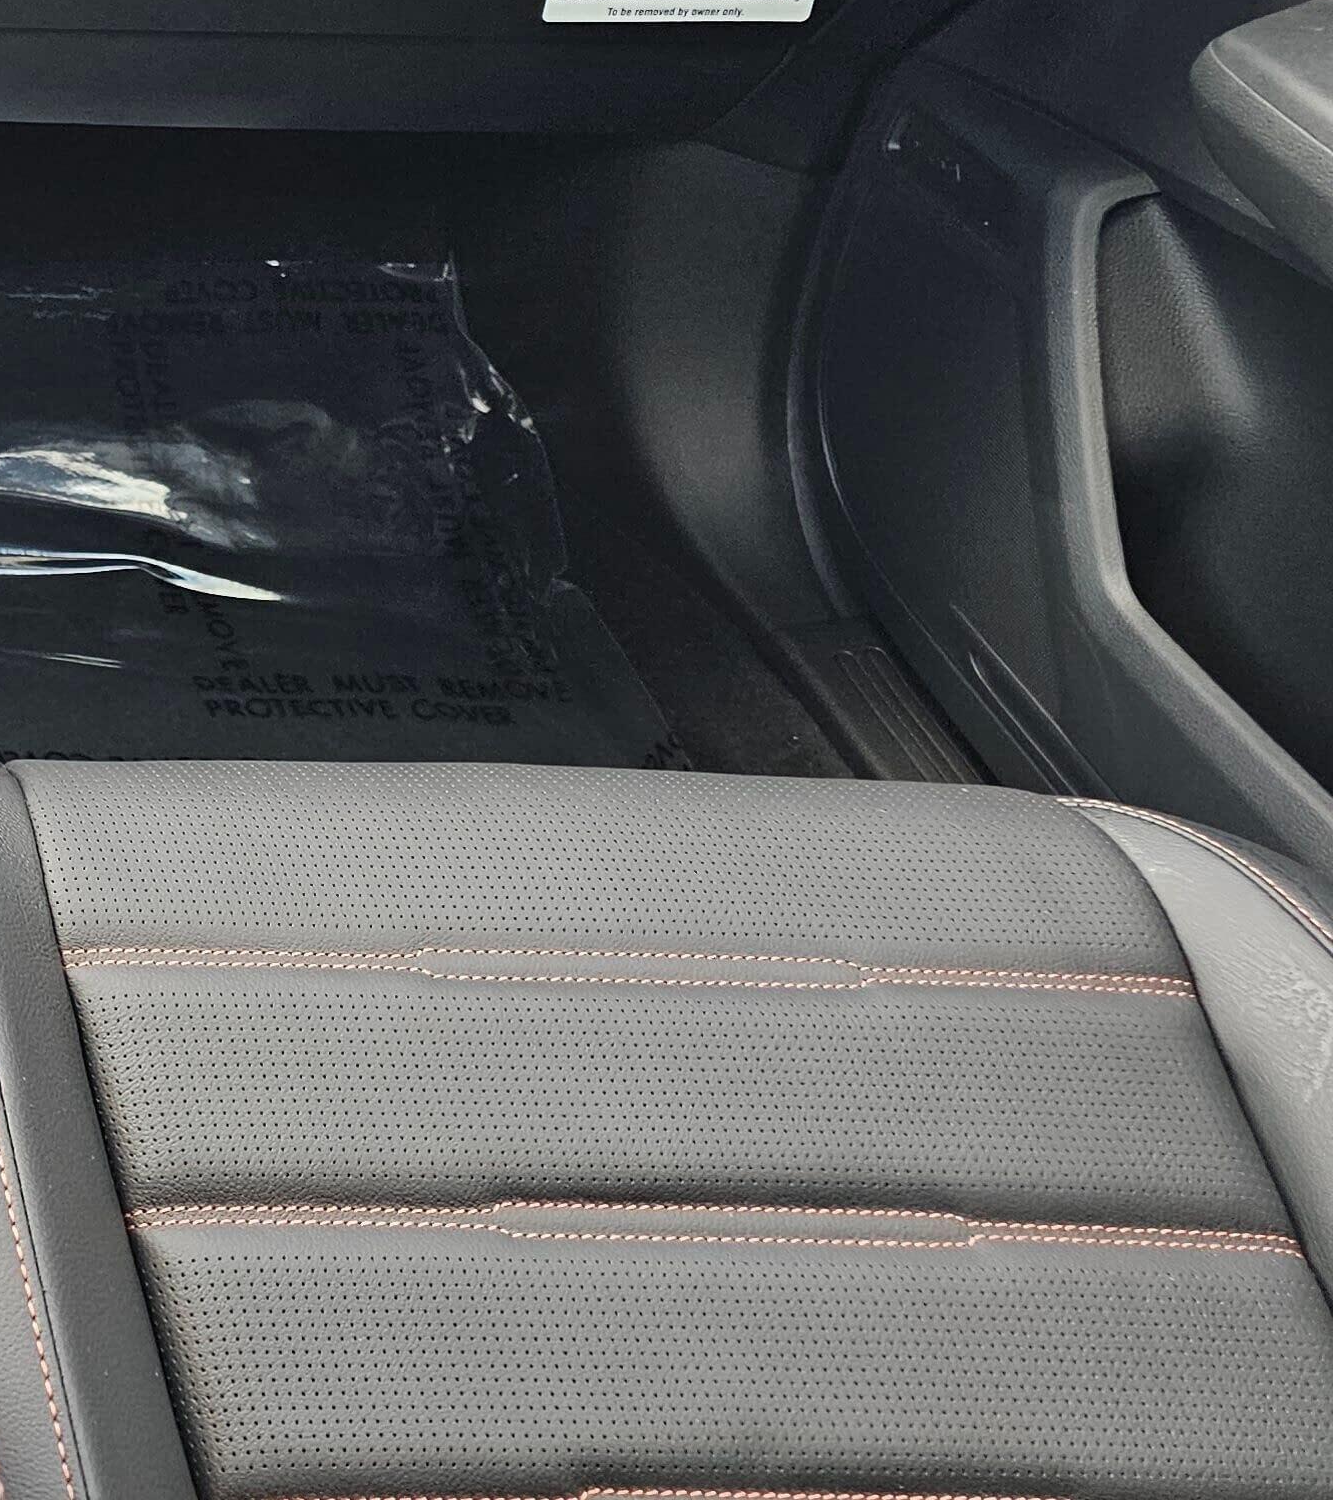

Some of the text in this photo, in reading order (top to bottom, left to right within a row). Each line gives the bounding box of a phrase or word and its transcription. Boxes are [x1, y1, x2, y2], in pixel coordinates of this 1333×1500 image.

[608, 8, 619, 16] To
[621, 8, 634, 16] be
[636, 8, 675, 16] removed
[678, 8, 689, 17] by
[723, 8, 745, 17] only.
[192, 673, 314, 695] DEALER
[204, 696, 399, 720] PROTECTIVE
